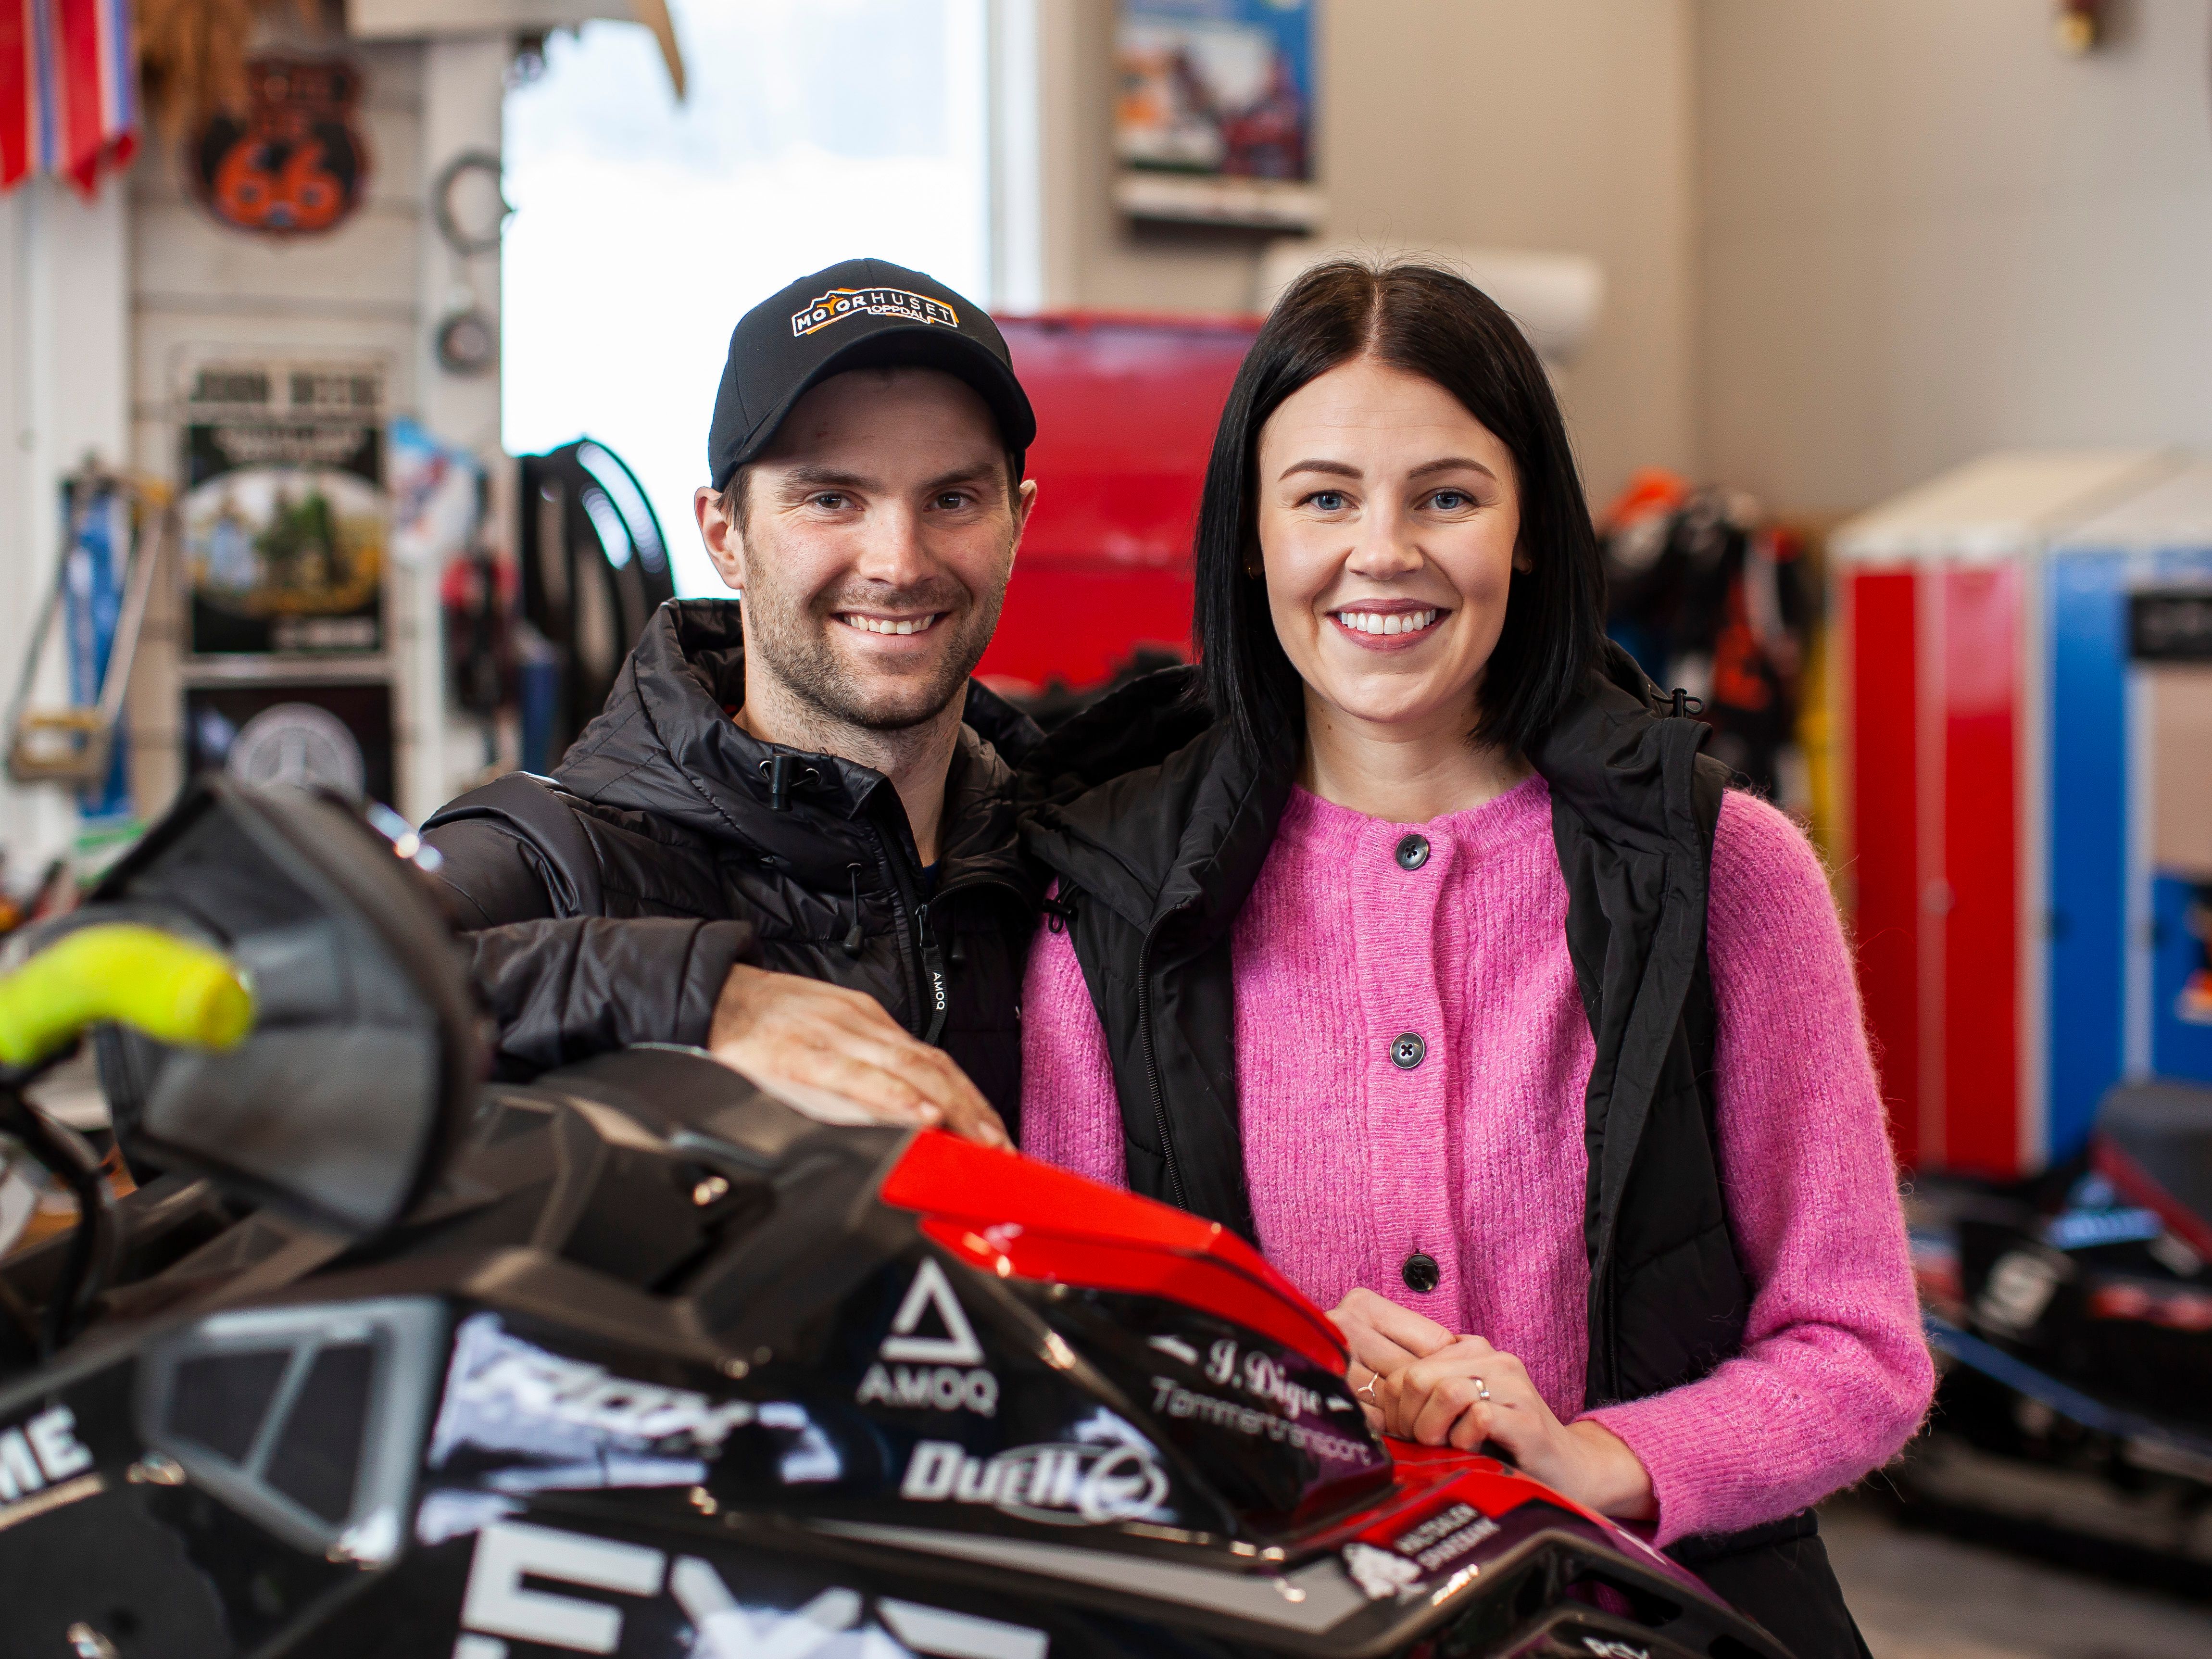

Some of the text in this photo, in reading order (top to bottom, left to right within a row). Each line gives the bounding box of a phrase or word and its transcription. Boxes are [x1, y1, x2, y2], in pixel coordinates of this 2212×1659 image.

[872, 305, 924, 319] OPPDAL
[932, 972, 945, 1010] AMOQ
[855, 1362, 999, 1419] AMOQ
